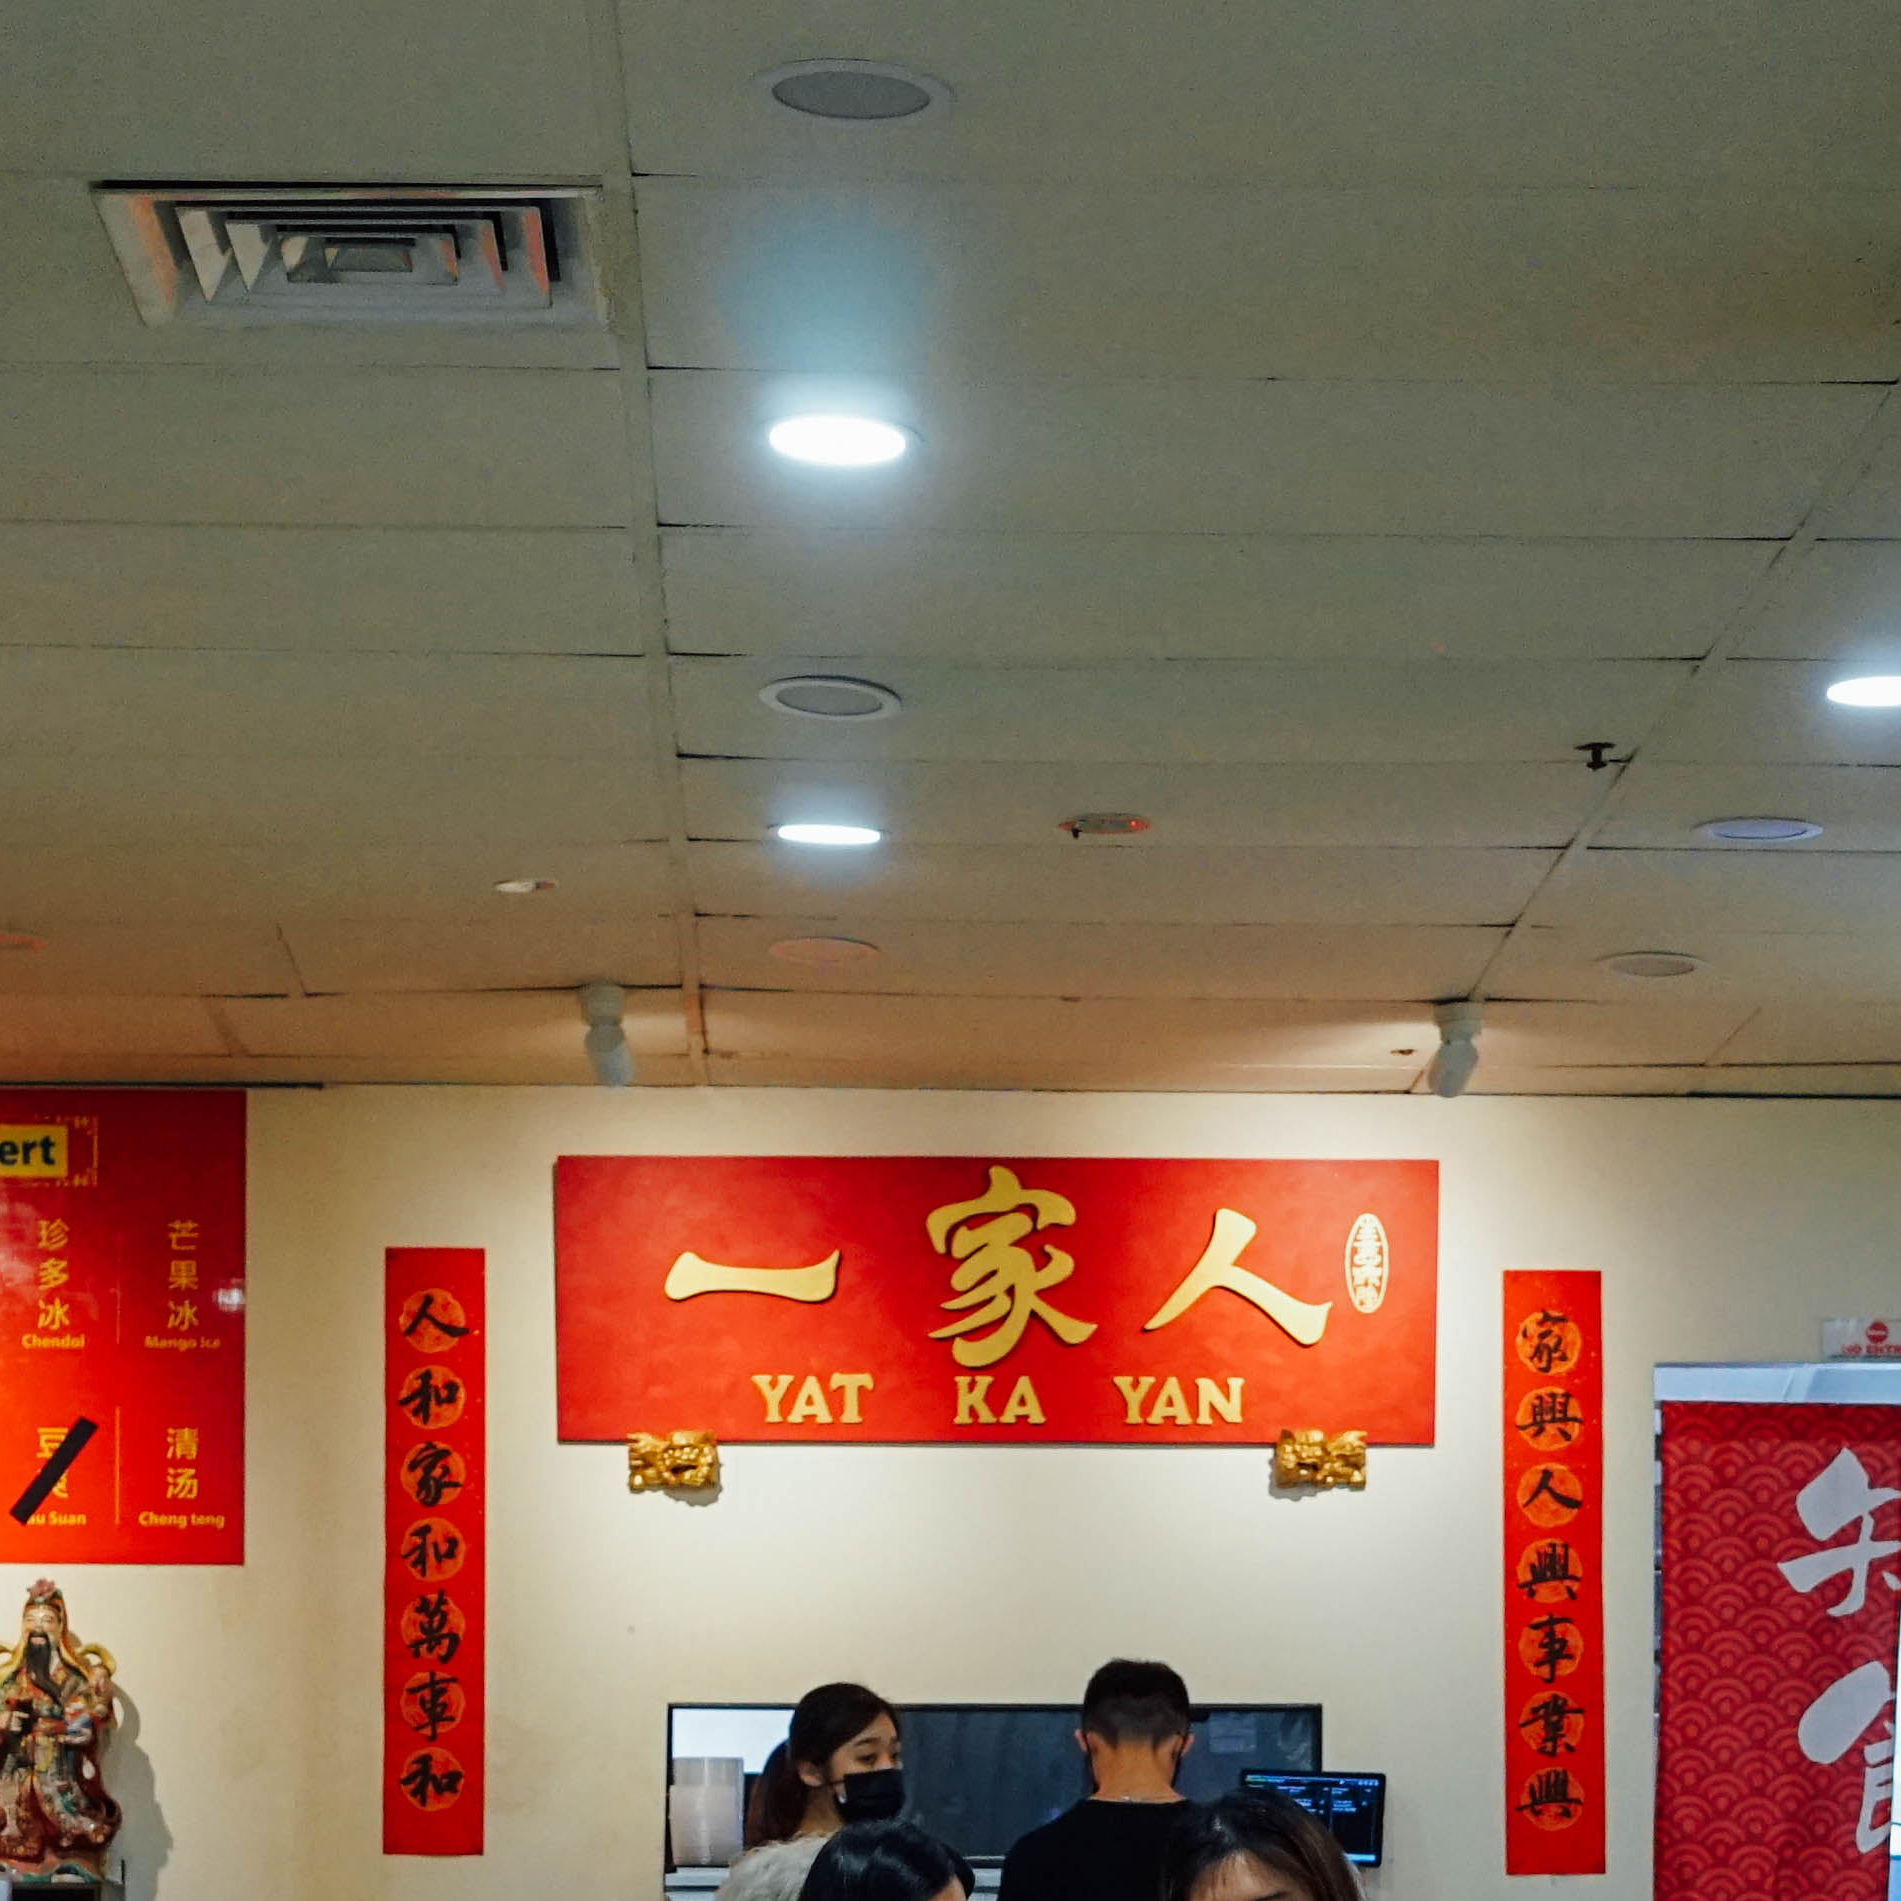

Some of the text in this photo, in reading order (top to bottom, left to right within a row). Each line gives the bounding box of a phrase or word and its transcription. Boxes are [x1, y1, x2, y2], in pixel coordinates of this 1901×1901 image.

[37, 1218, 70, 1331] 珍多冰
[167, 1219, 200, 1332] 芒果冰
[664, 1166, 1333, 1368] 一家人
[21, 1333, 85, 1349] Chendol
[752, 1374, 1244, 1425] YAT KA YAN
[167, 1427, 199, 1500] 清汤
[49, 1511, 87, 1526] Suan
[138, 1512, 186, 1530] Cheng
[1514, 1309, 1584, 1818] 家興人興事業興
